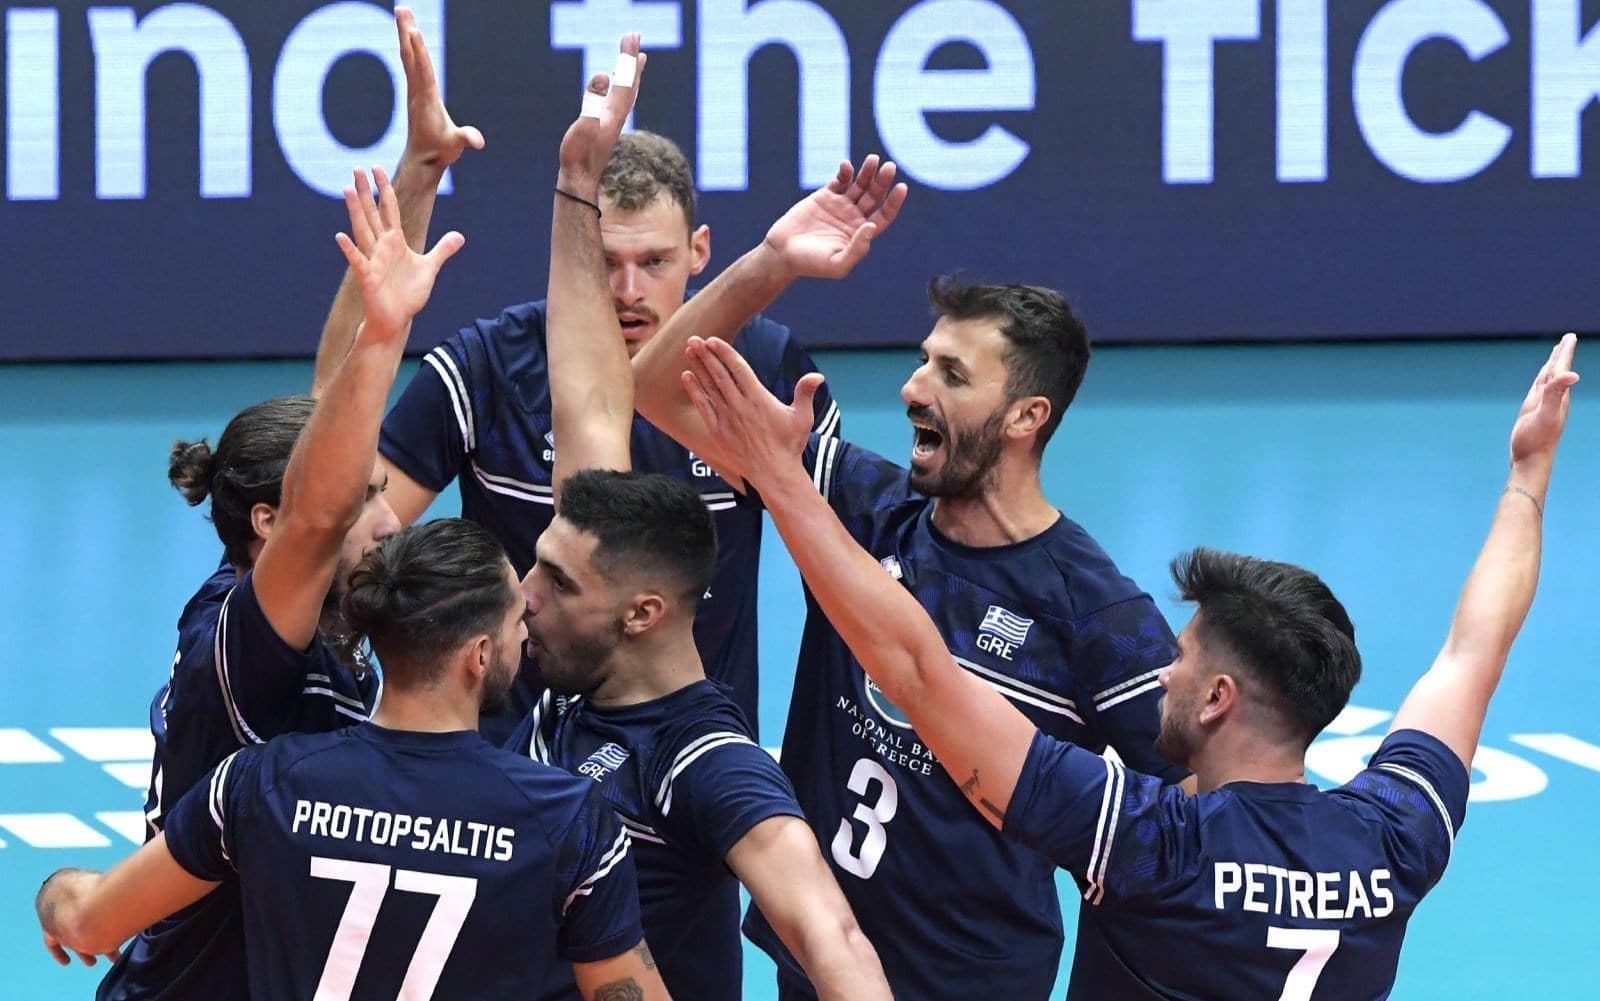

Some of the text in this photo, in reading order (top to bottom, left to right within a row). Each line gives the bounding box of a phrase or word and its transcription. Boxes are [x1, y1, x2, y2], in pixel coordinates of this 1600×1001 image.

[976, 633, 1019, 661] GRE
[836, 696, 940, 763] NAONAL BA
[577, 761, 612, 783] GRE
[292, 799, 516, 862] PROTOPSALTIS
[831, 758, 898, 879] 3
[1214, 861, 1394, 920] PETREAS
[310, 856, 478, 1001] 77
[1266, 926, 1341, 1001] 7
